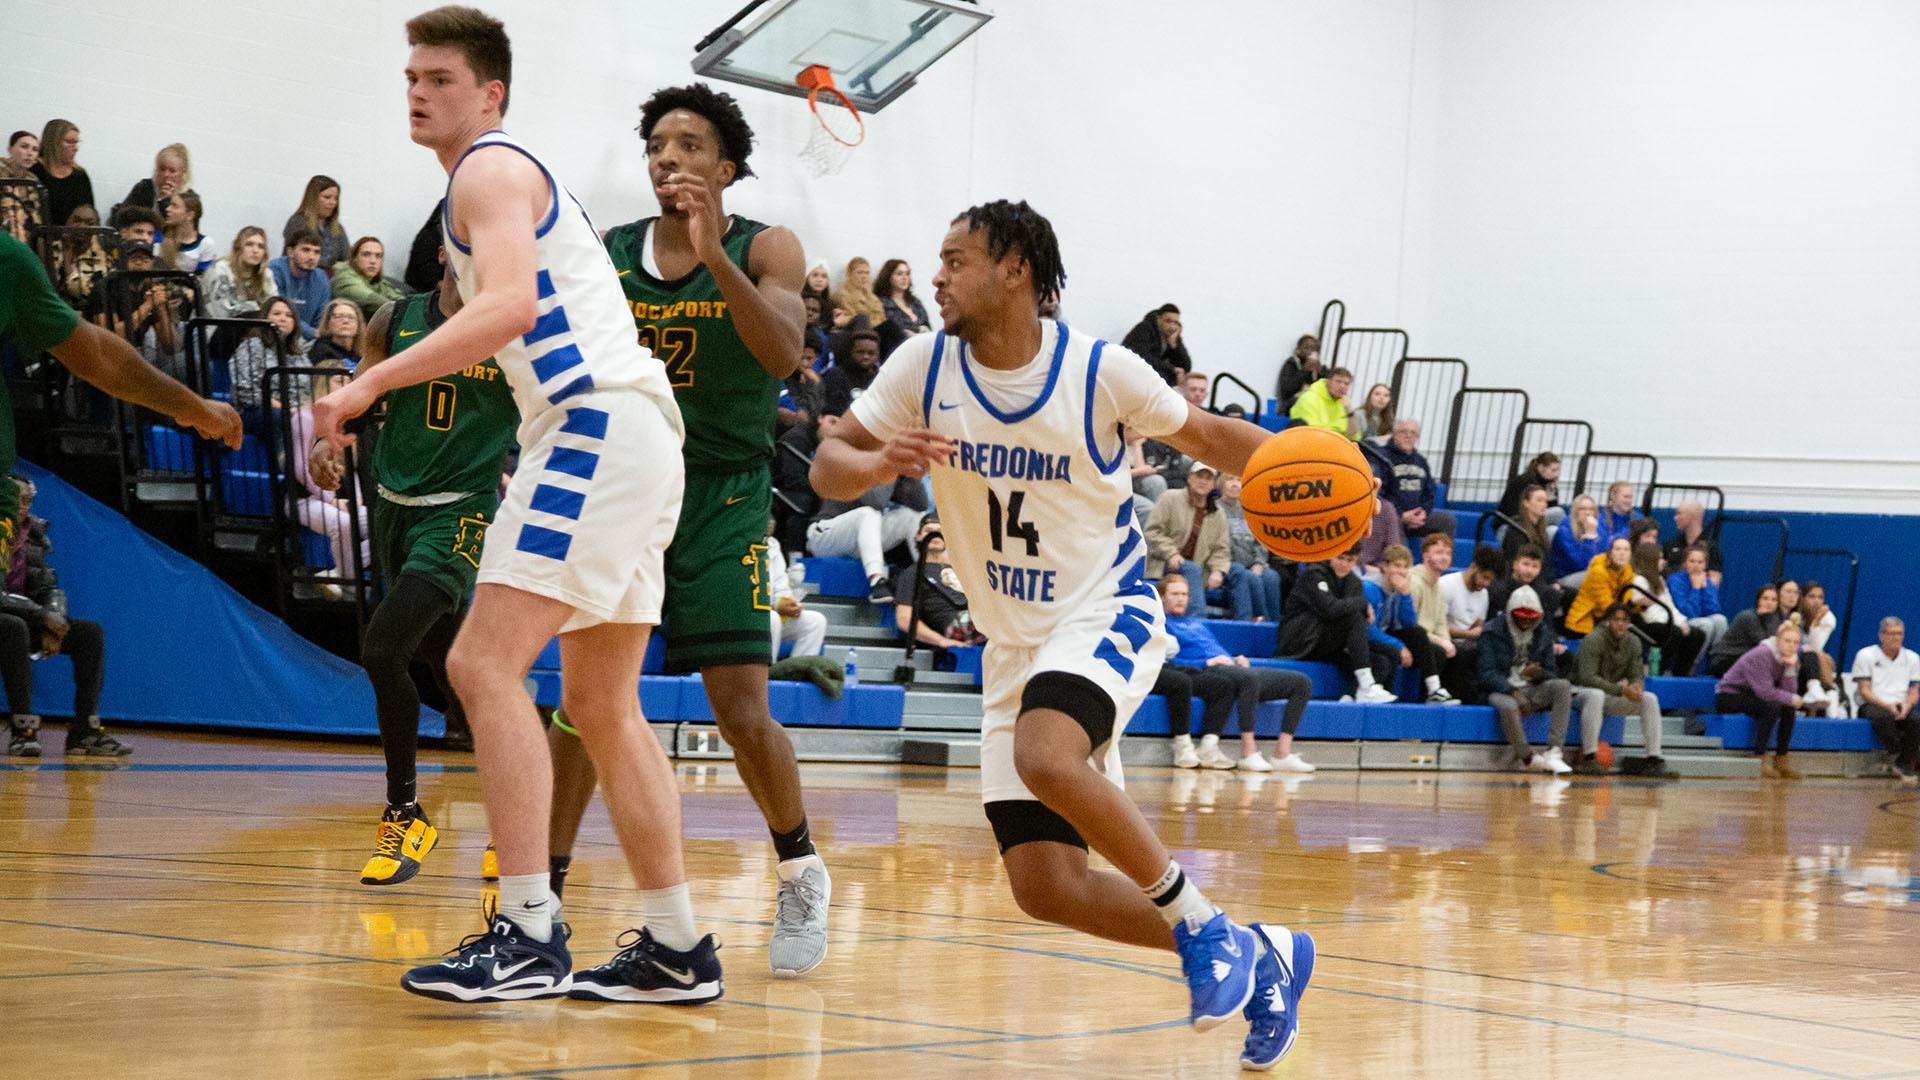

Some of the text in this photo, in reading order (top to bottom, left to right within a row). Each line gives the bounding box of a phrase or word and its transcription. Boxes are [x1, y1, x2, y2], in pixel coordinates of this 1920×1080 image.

[427, 380, 456, 432] 0
[949, 438, 1072, 484] FREDONIA
[1268, 479, 1332, 504] NCAA
[987, 487, 1040, 557] 14
[1260, 515, 1352, 546] Wilson
[985, 559, 1057, 602] STATE
